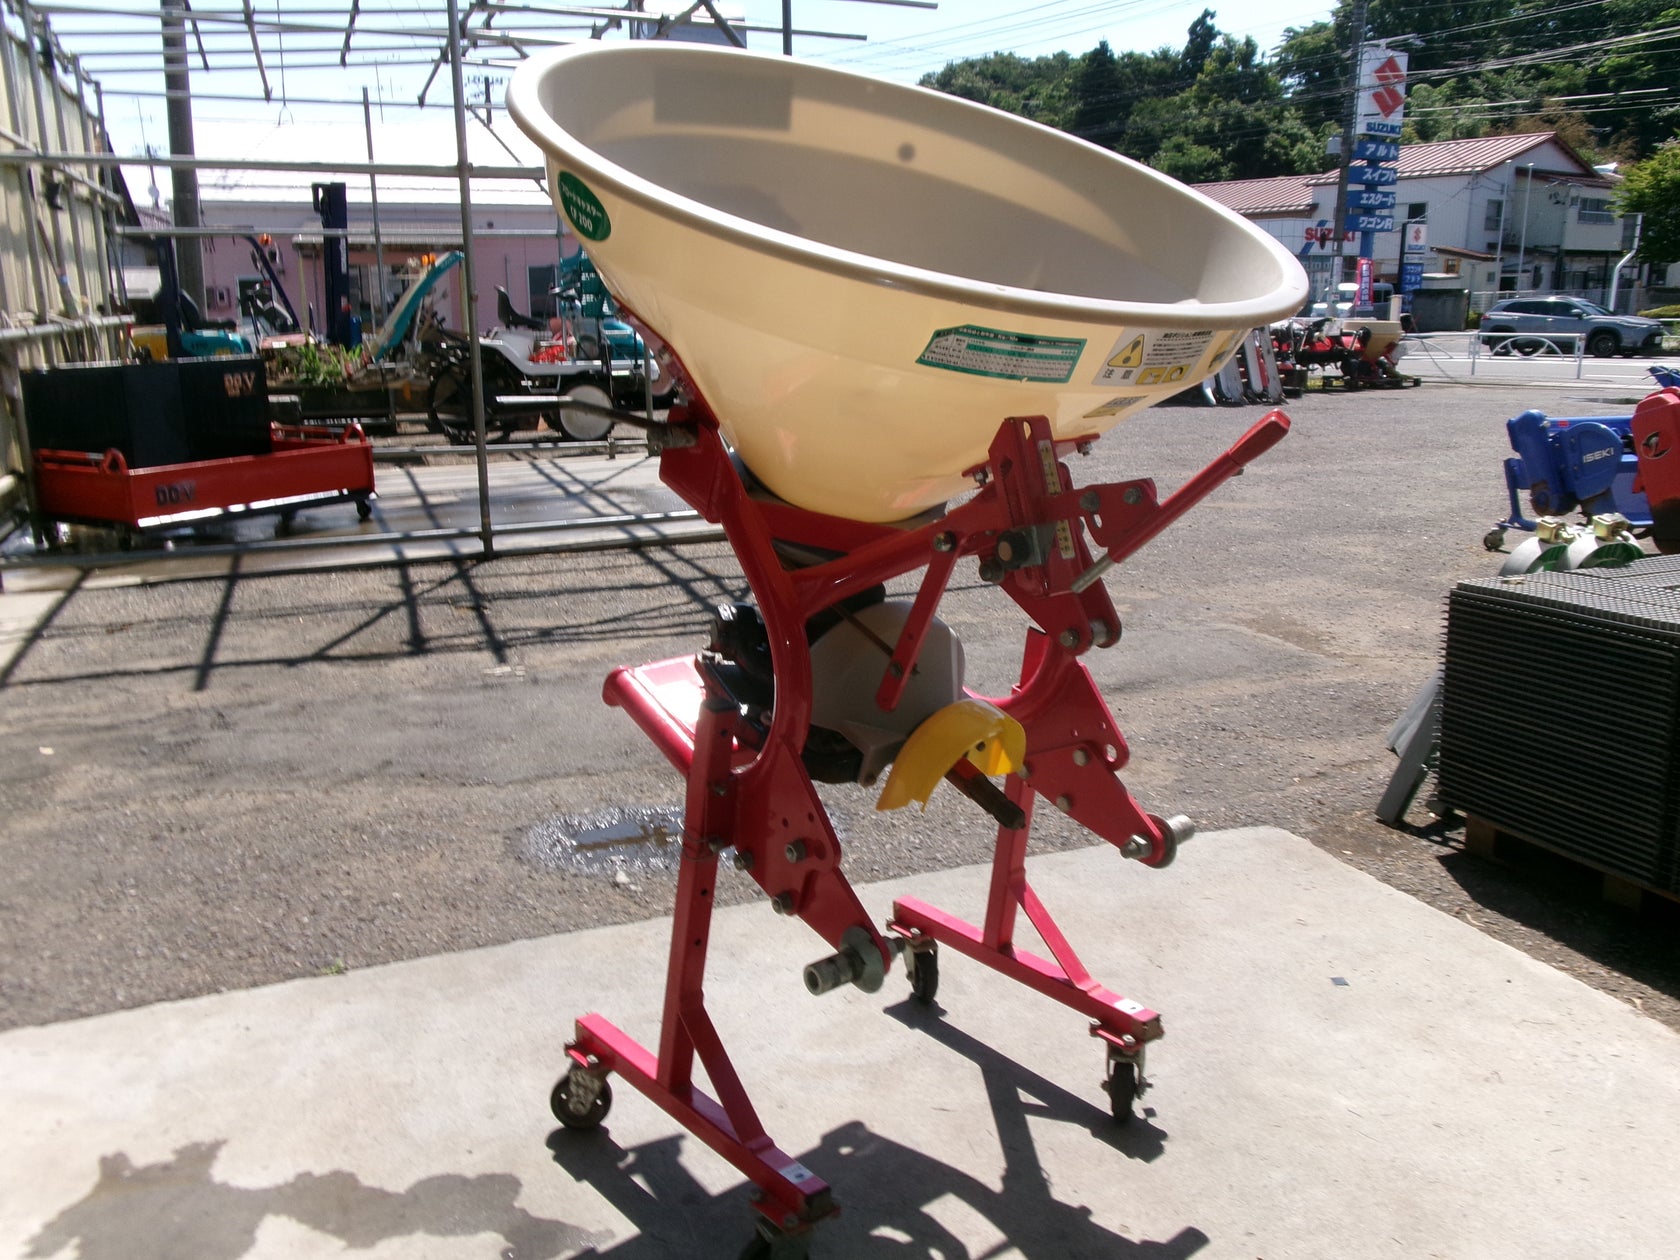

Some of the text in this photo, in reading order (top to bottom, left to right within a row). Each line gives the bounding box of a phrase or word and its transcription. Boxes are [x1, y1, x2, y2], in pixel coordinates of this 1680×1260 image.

[1366, 122, 1401, 135] SUZUKI
[1366, 143, 1398, 158] アルト
[1362, 168, 1396, 181] スイフト
[1360, 193, 1396, 206] エスクード
[1359, 216, 1393, 229] ワゴンR
[1304, 227, 1356, 242] SUZKI
[1583, 447, 1615, 463] ISEKI
